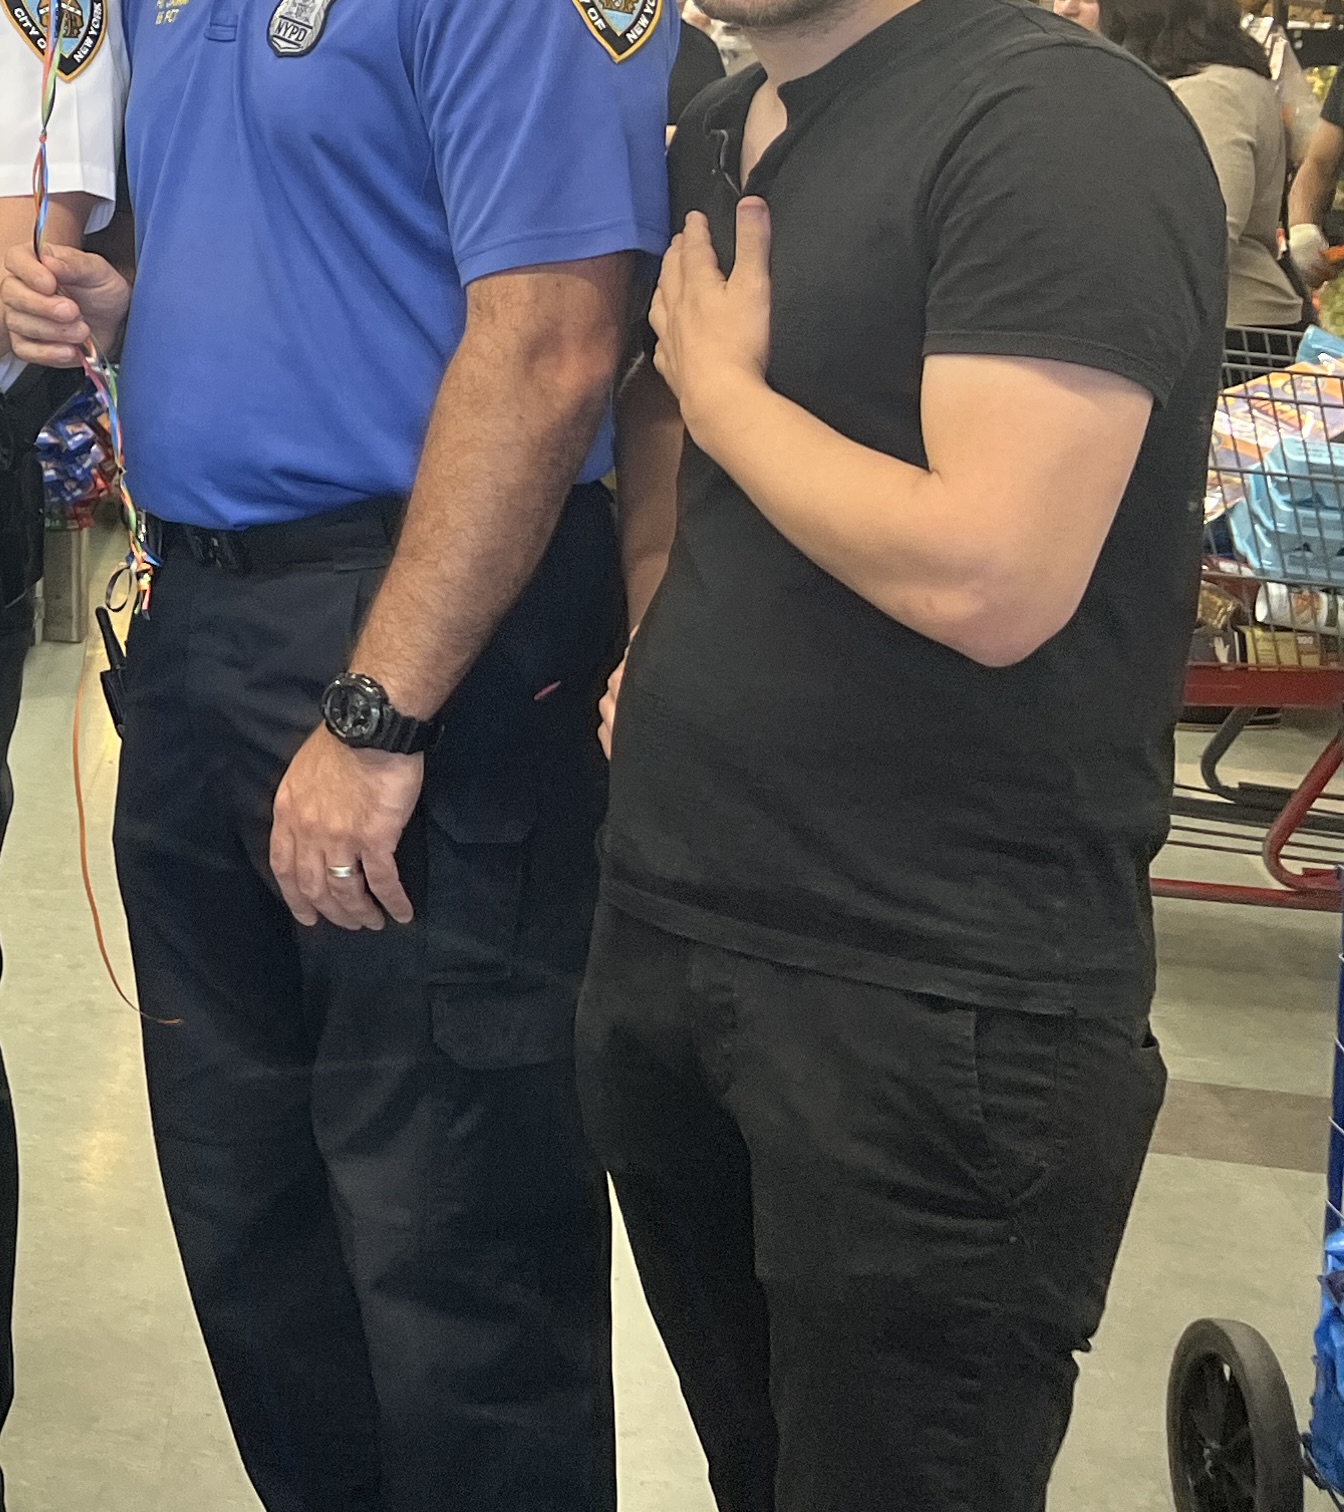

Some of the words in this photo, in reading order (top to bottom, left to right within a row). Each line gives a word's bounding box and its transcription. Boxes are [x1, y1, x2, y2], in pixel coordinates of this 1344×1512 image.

[14, 8, 40, 35] CITY
[73, 36, 94, 63] NEW
[88, 2, 102, 36] YORK
[274, 20, 308, 42] NYPD
[587, 8, 606, 31] OF
[625, 14, 649, 44] NEW
